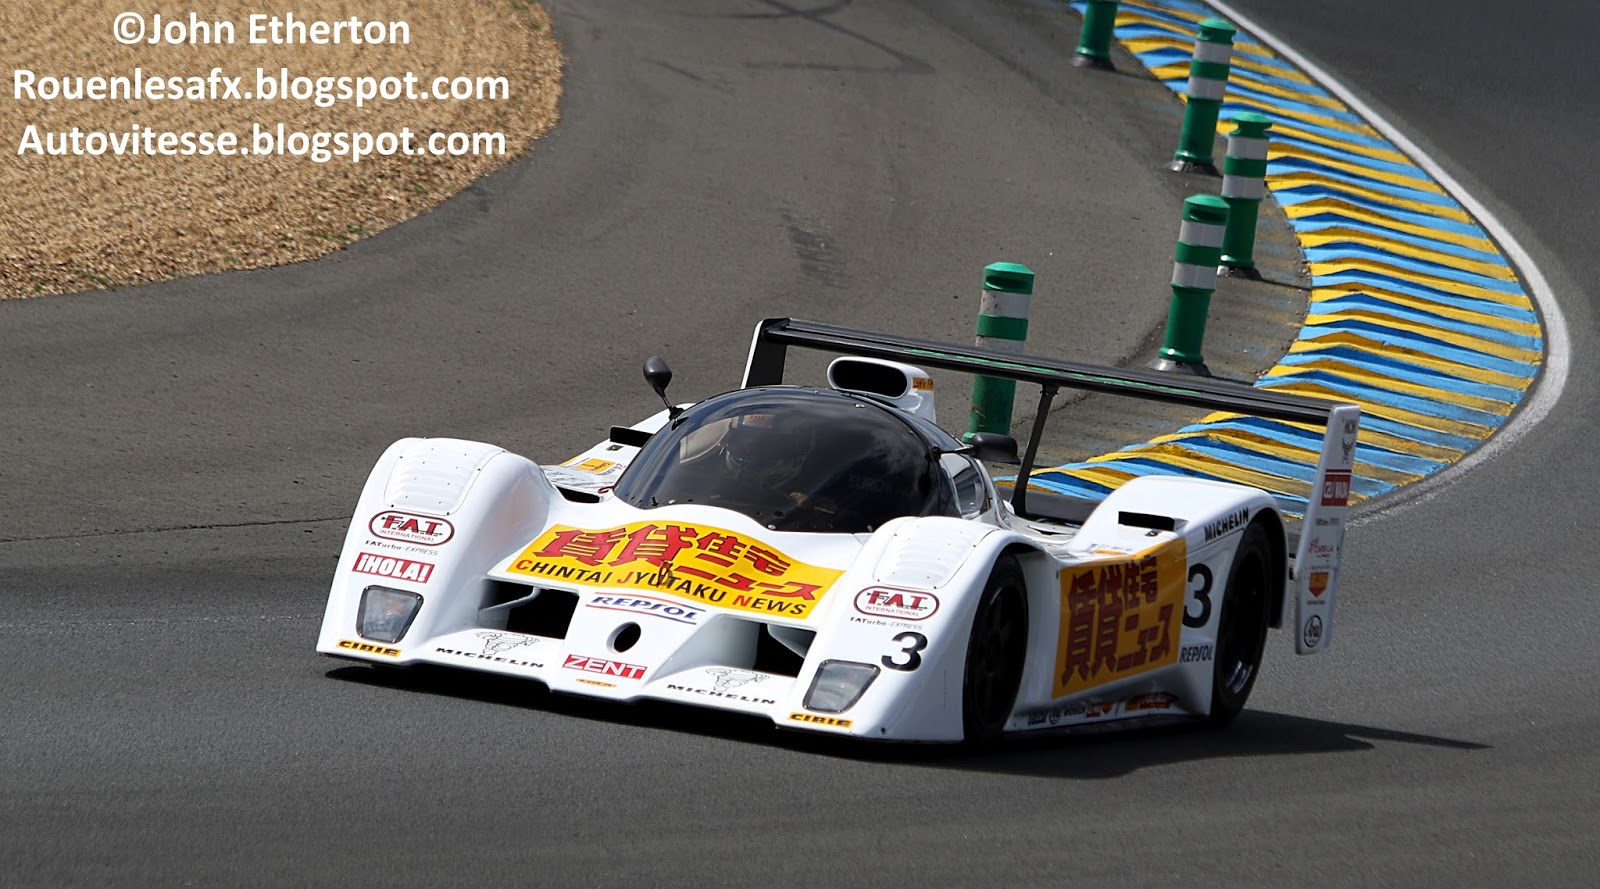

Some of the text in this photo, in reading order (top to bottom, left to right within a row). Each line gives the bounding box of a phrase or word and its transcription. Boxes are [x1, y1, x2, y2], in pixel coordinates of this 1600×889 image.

[1204, 507, 1249, 542] MICHELIN
[380, 530, 435, 542] INTERNATIONAL
[516, 559, 807, 615] CHINTAI JYUTAKU NEWS
[1182, 563, 1213, 629] 3
[592, 596, 697, 621] REPSOL
[865, 606, 919, 617] INTERNATIONAL
[339, 640, 400, 656] CIBIE
[435, 648, 545, 669] MICHELIN
[881, 631, 928, 672] 3
[1179, 645, 1213, 664] REPSOL
[564, 655, 646, 678] ZENT
[666, 684, 776, 705] MICHELIN
[790, 713, 851, 727] CIBIE
